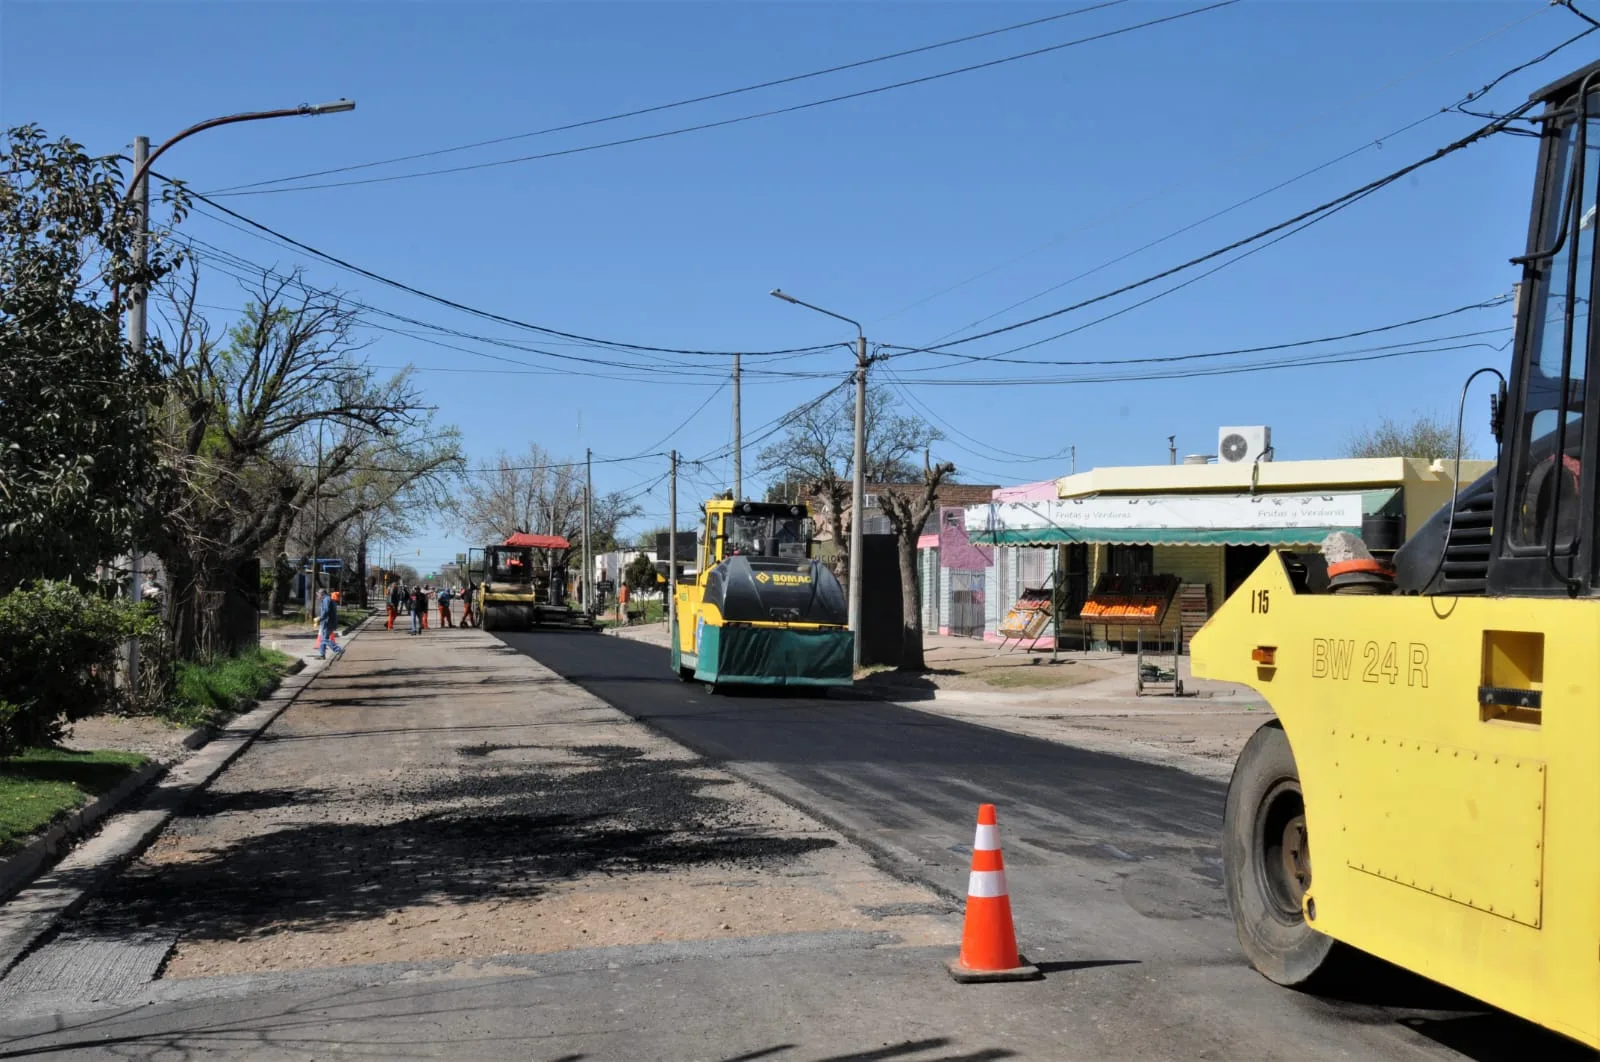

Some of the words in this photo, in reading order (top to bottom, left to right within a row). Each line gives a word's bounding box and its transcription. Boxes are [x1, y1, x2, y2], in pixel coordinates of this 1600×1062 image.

[1312, 637, 1355, 680] BW
[1362, 640, 1399, 685] 24
[1407, 642, 1430, 689] R
